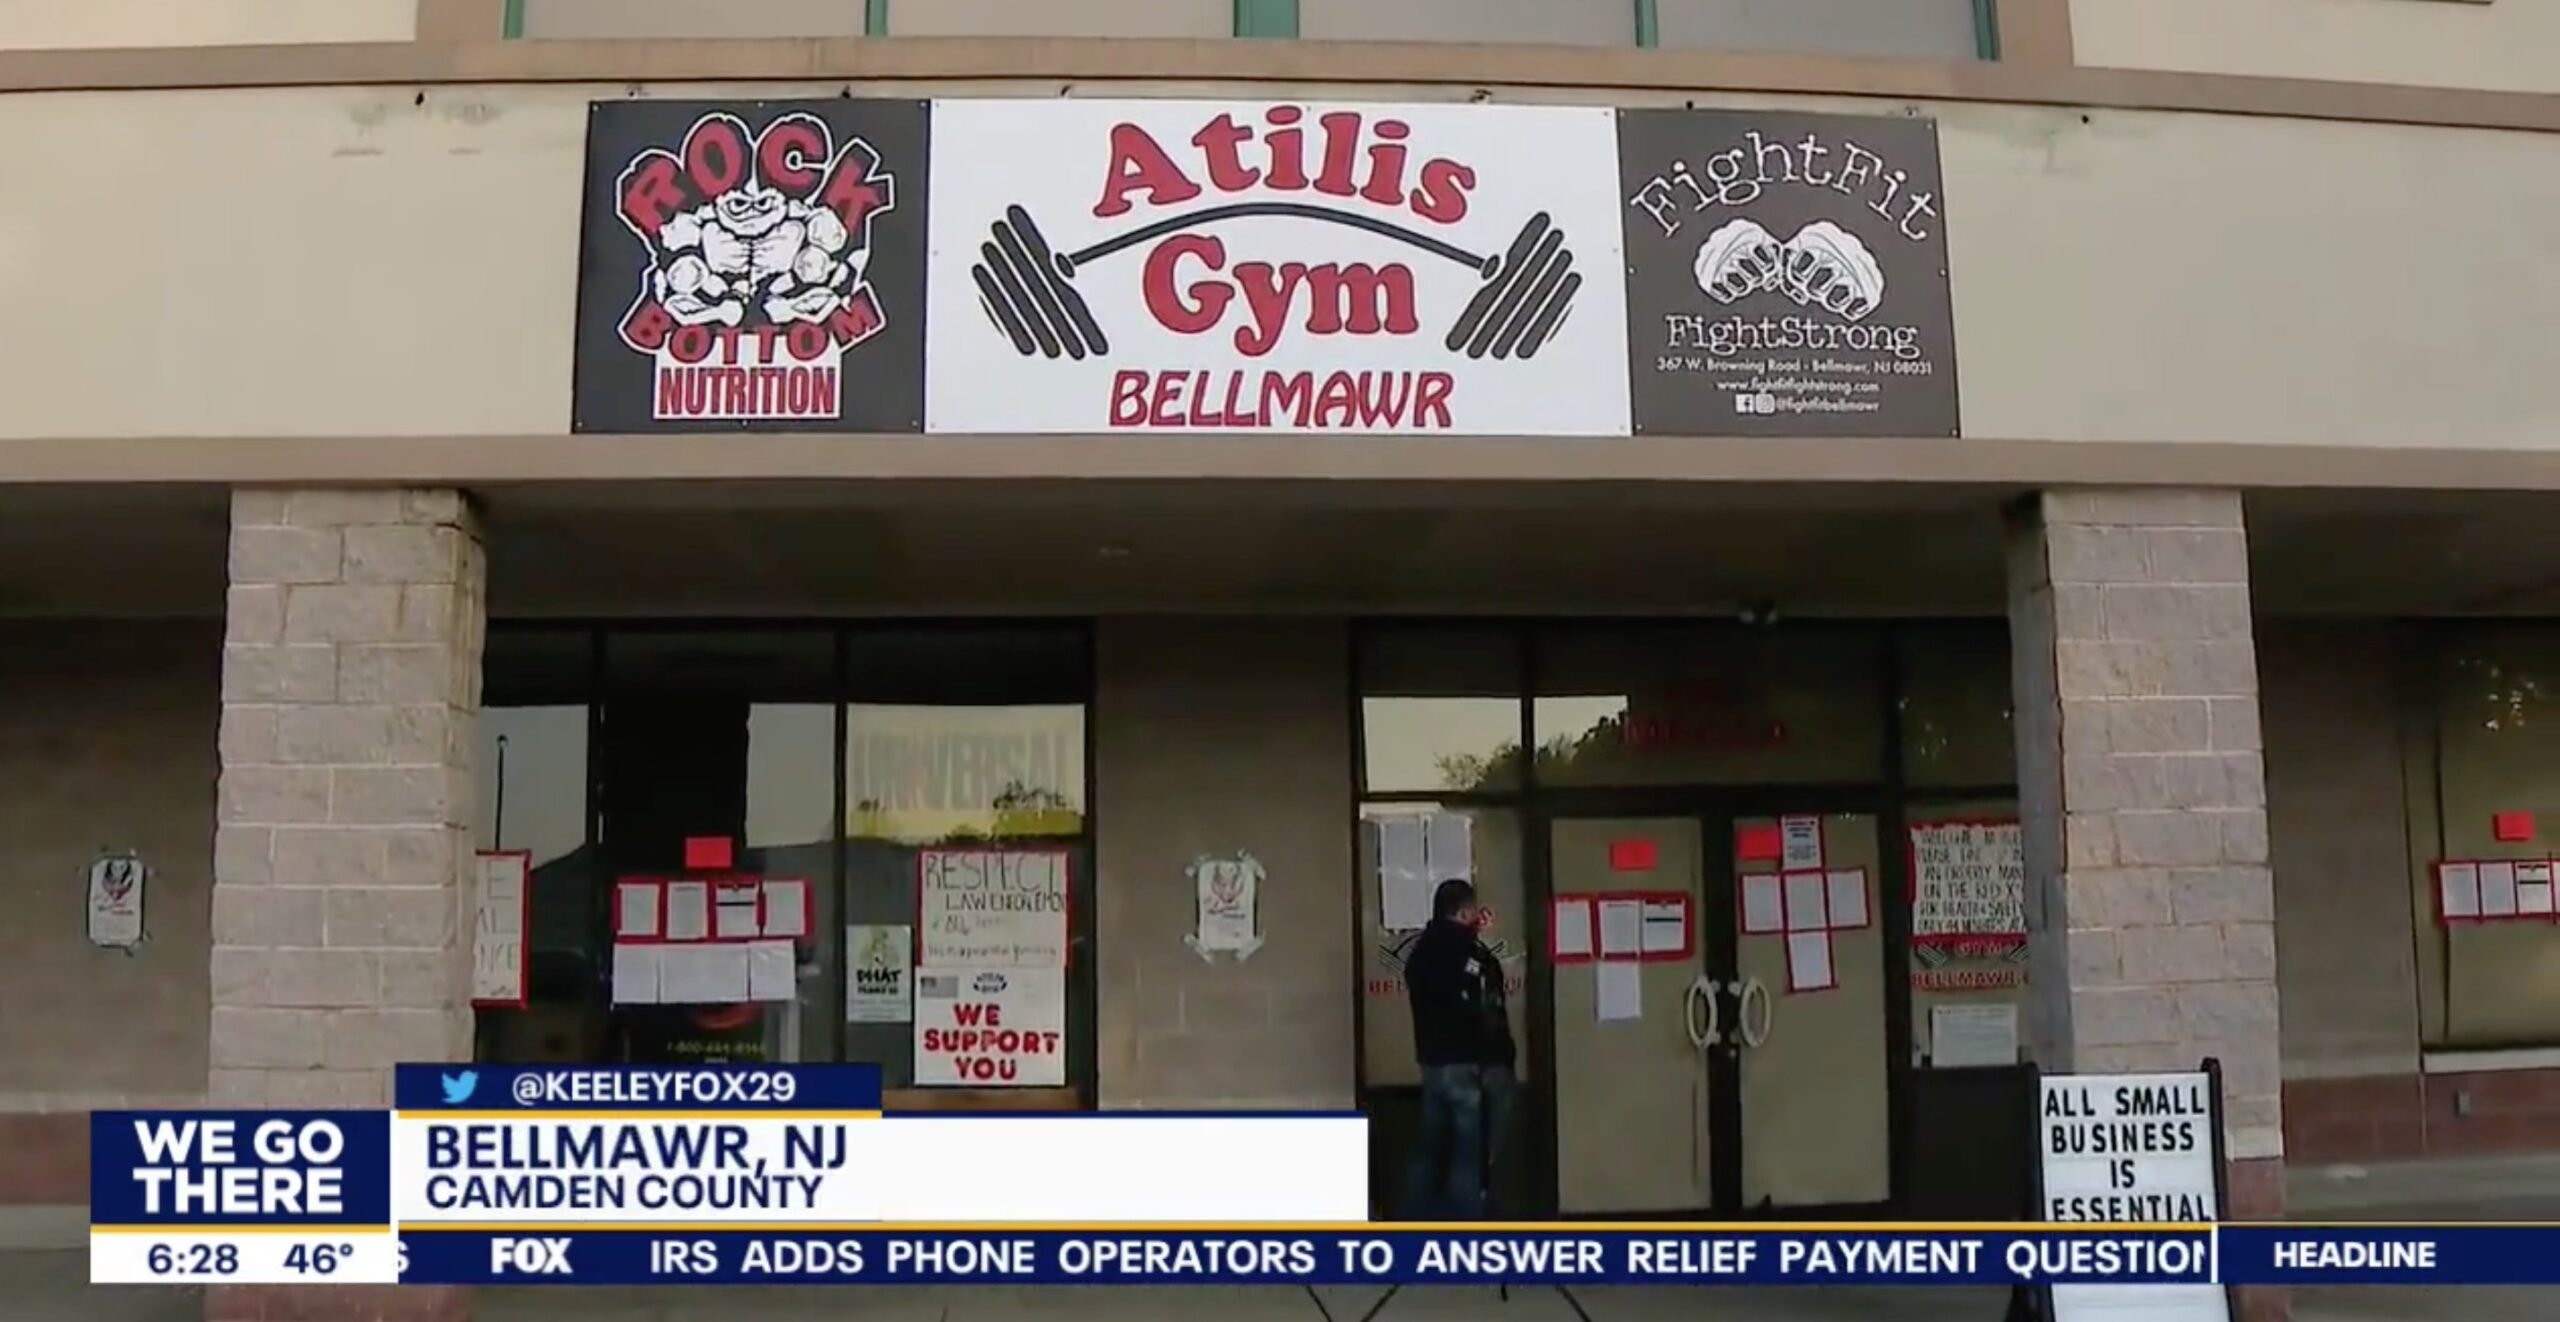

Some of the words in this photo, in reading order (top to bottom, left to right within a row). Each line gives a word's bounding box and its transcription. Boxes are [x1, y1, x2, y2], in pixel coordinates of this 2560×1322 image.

[620, 119, 884, 235] ROCK
[1093, 105, 1476, 223] Atilis
[1631, 130, 1937, 240] FightFit
[1143, 233, 1419, 357] Gym
[623, 289, 882, 364] BOTTOM
[1665, 315, 1921, 359] FightStrong
[1657, 358, 1681, 371] 367
[1707, 359, 1765, 374] Browning
[1768, 359, 1800, 371] Road
[1812, 359, 1869, 374] Bellmawr,
[1874, 361, 1890, 373] NJ
[1893, 361, 1932, 374] 08031
[659, 366, 836, 415] NUTRITION
[1109, 371, 1453, 427] BELLMAWR
[925, 853, 1060, 892] RESPECT
[954, 1003, 1001, 1027] WE
[924, 1028, 1060, 1055] SUPPORT
[954, 1057, 1017, 1081] YOU
[2045, 1087, 2096, 1117] ALL
[2116, 1085, 2206, 1116] SMALL
[2052, 1122, 2194, 1154] BUSINESS
[2111, 1158, 2135, 1188] IS
[2052, 1194, 2212, 1222] ESSENTIAL
